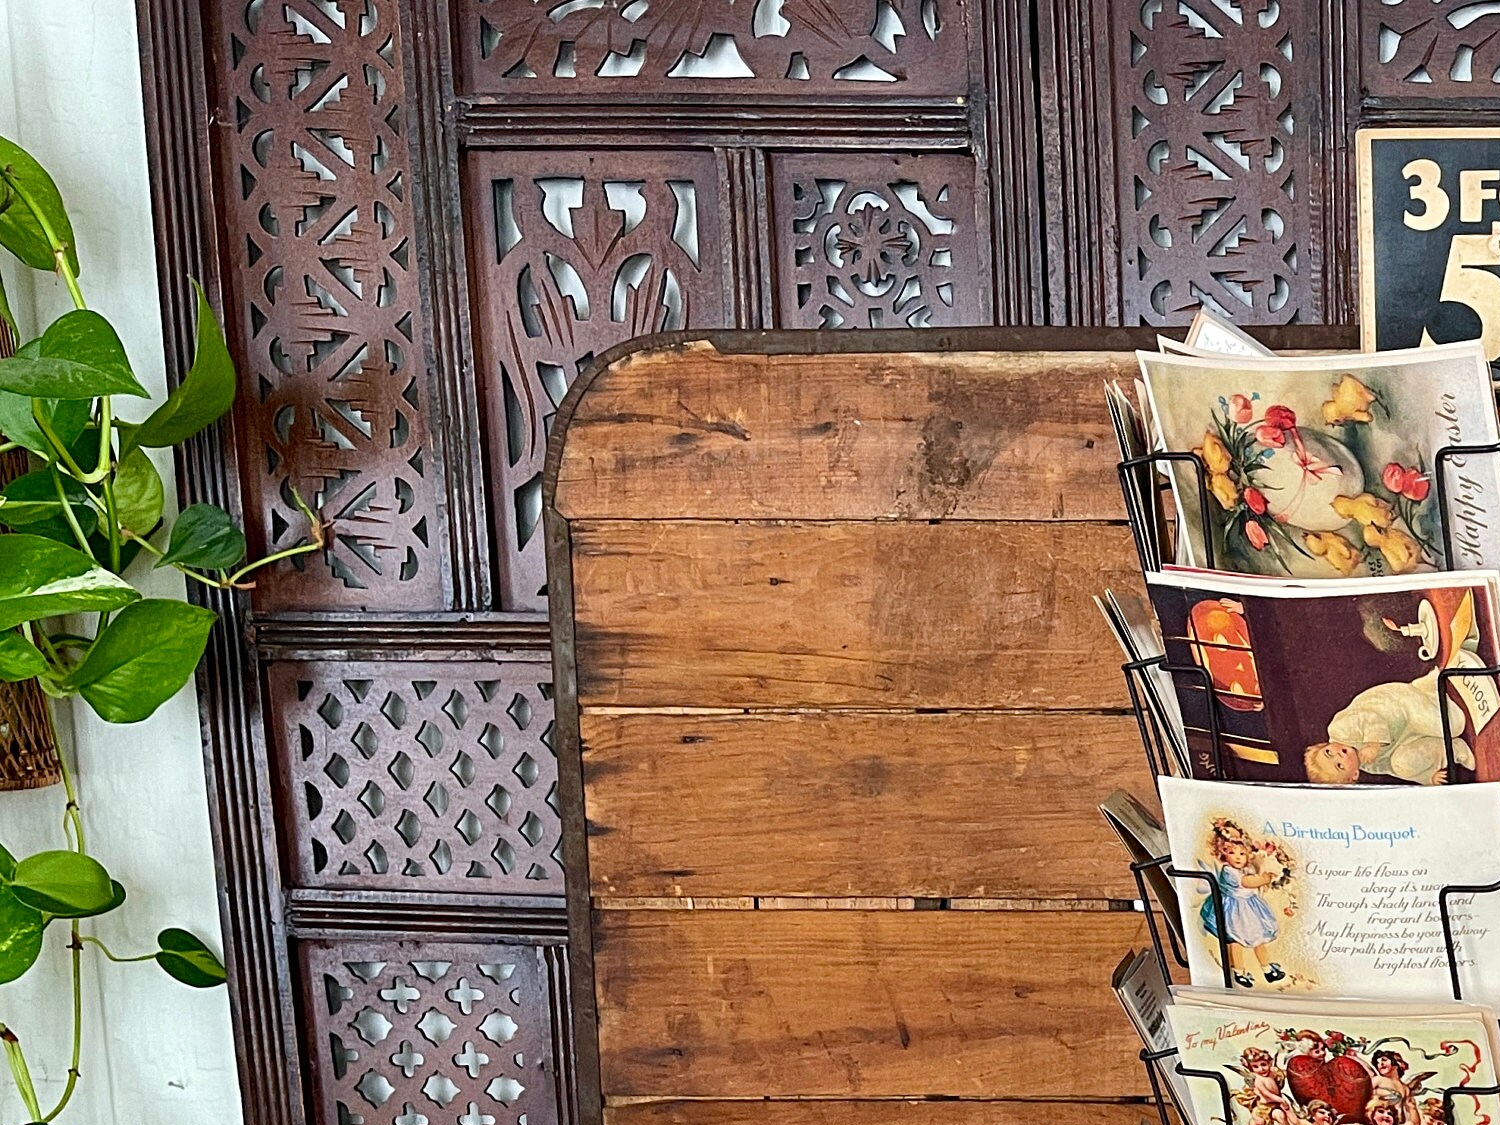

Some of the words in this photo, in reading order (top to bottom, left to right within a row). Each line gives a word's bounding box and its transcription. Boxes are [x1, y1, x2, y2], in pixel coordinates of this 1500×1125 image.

[1402, 159, 1450, 231] 3
[1454, 475, 1488, 566] Happy
[1463, 676, 1490, 717] GHOST
[1263, 821, 1278, 836] A
[1282, 821, 1350, 848] Birthday
[1325, 867, 1352, 880] your
[1354, 865, 1372, 877] life
[1374, 862, 1409, 877] flows
[1412, 868, 1428, 876] on
[1360, 882, 1396, 898] along
[1400, 881, 1417, 893] it's
[1316, 892, 1368, 913] Through
[1370, 897, 1409, 913] shady
[1450, 894, 1475, 905] and
[1367, 909, 1421, 929] fragrant
[1307, 920, 1339, 938] May
[1340, 923, 1400, 942] Happiness
[1400, 928, 1414, 938] be
[1319, 940, 1352, 960] Your
[1351, 943, 1377, 956] path
[1378, 943, 1392, 955] be
[1435, 941, 1462, 953] wth
[1373, 958, 1428, 976] brightest
[1185, 1031, 1200, 1050] To
[1201, 1038, 1217, 1051] my
